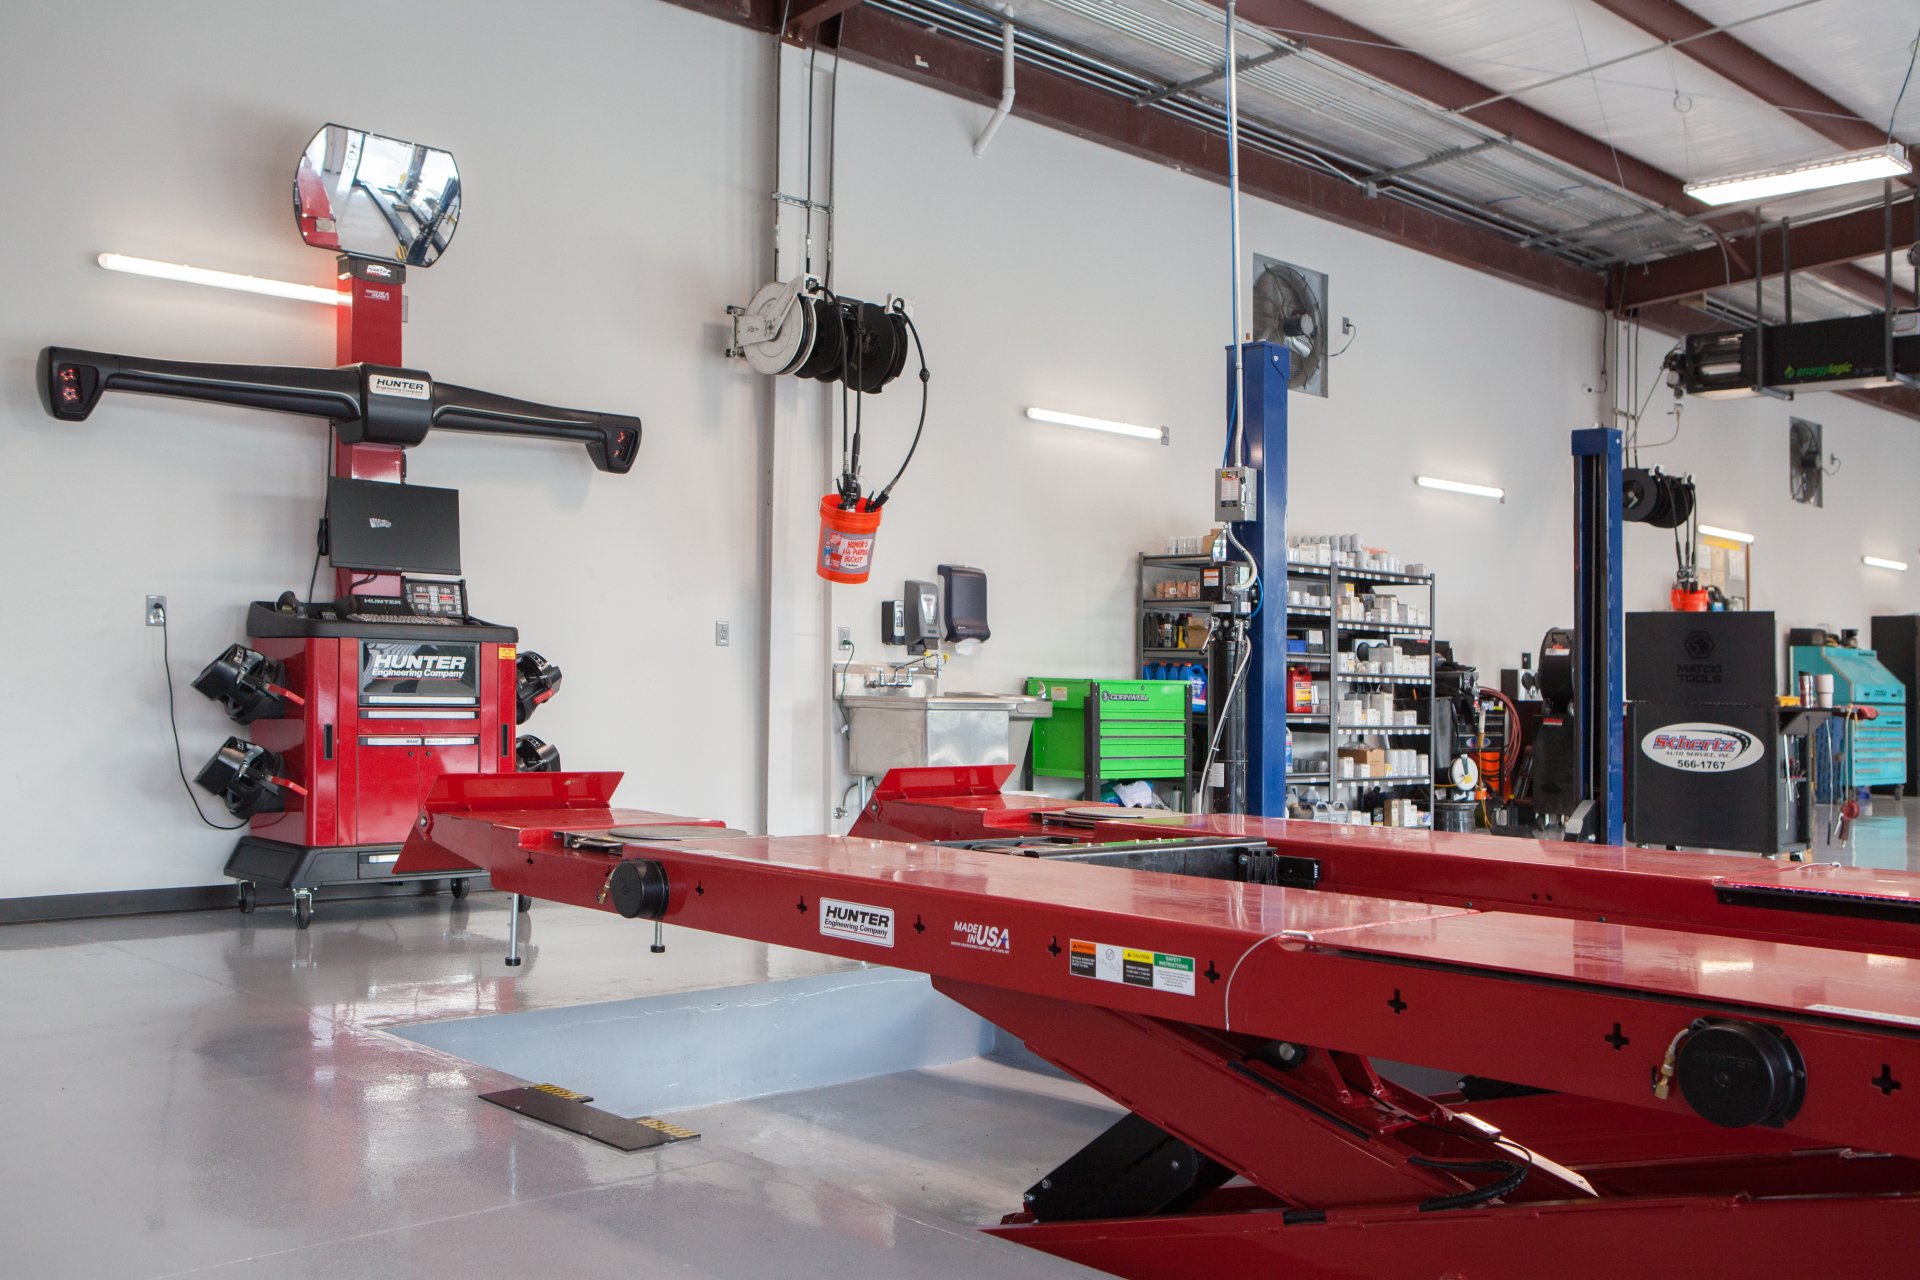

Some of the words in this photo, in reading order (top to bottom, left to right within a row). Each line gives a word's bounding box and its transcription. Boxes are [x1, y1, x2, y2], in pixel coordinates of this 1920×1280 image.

[377, 379, 424, 390] HUNTER
[374, 655, 466, 670] HUNTER
[372, 669, 422, 678] Engineering
[424, 669, 464, 678] Company
[1677, 664, 1722, 673] MATCO
[1677, 674, 1722, 683] TOOLS
[1653, 734, 1738, 752] Schertz
[1677, 760, 1726, 770] 566-1767
[826, 905, 890, 928] HUNTER
[824, 918, 859, 930] Engineering
[859, 924, 888, 936] Company
[954, 921, 978, 934] MADE
[967, 934, 977, 944] IN
[976, 924, 1010, 950] USA
[1132, 952, 1150, 960] CAUTION
[1165, 955, 1182, 963] SAFETY
[1158, 960, 1189, 970] INSTRUCTIONS
